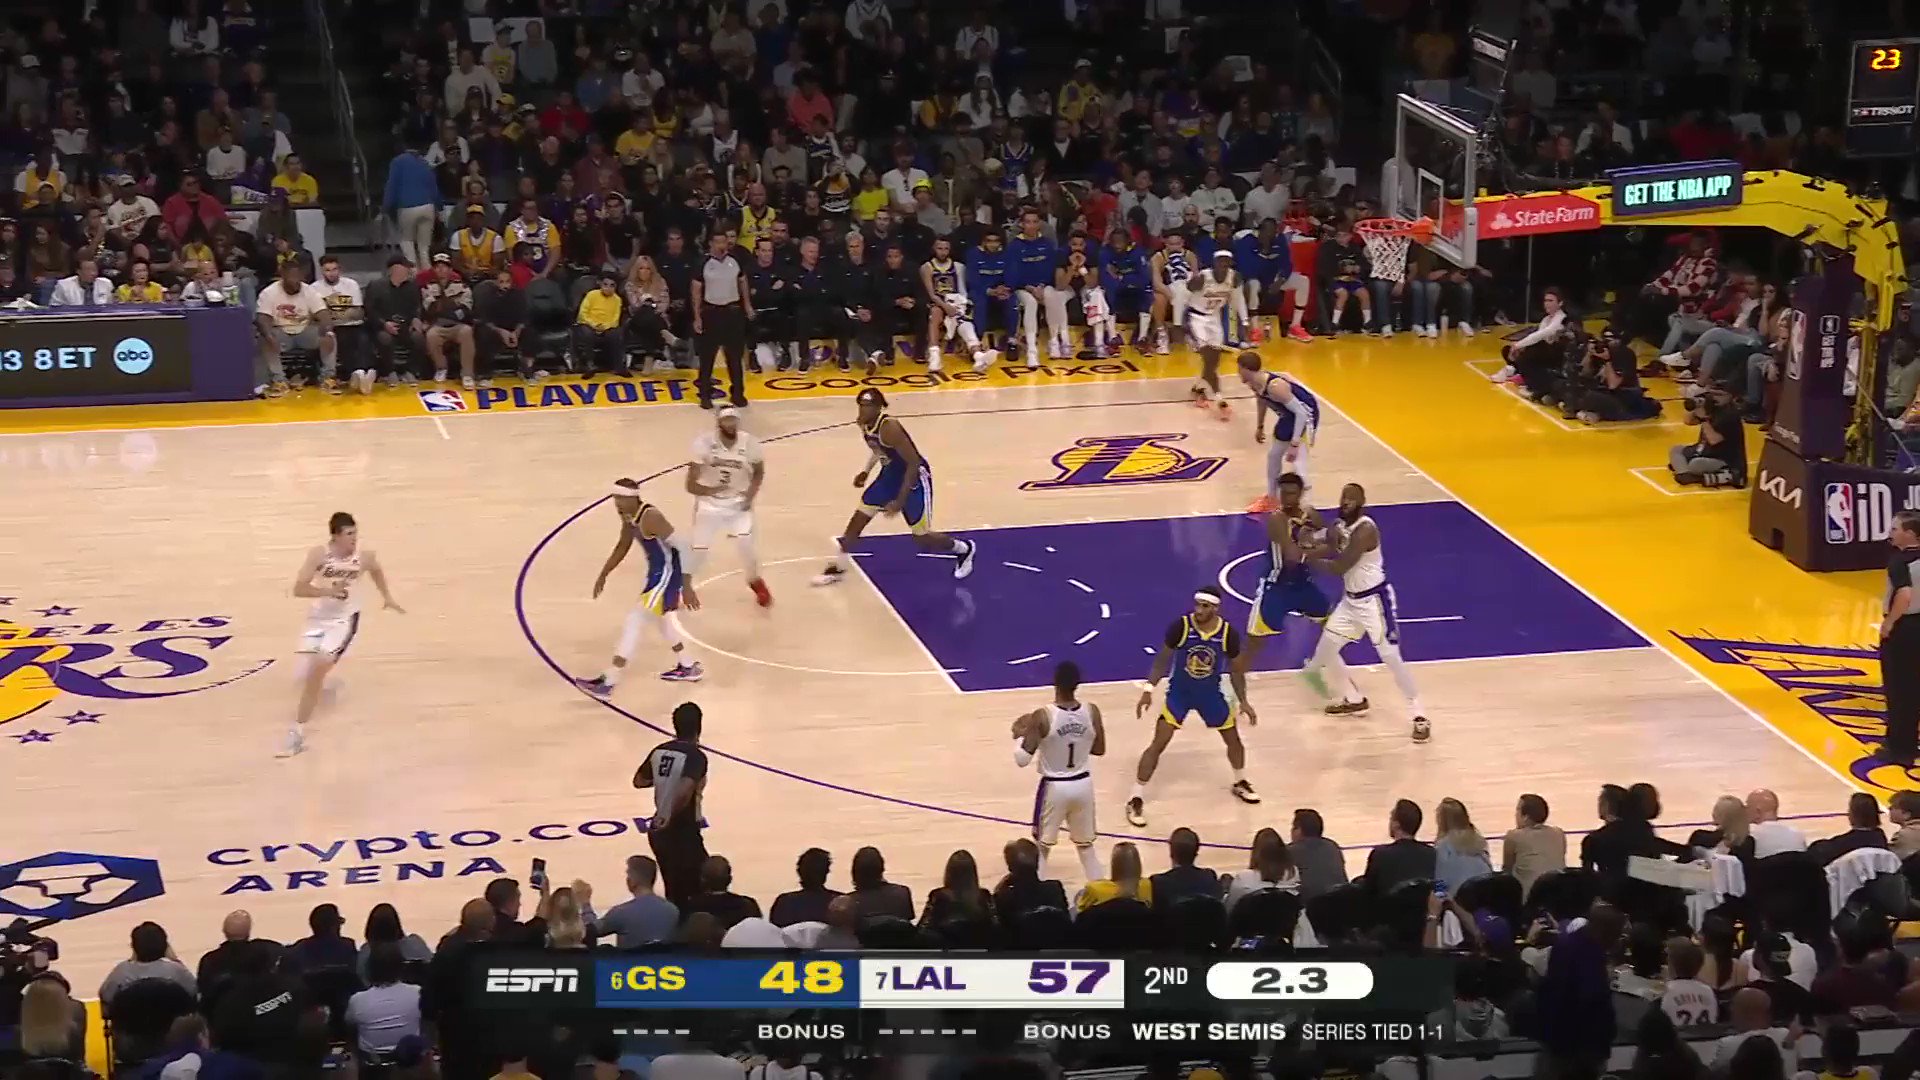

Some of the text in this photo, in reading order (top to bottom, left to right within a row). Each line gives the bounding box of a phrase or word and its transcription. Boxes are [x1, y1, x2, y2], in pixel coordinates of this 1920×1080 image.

[1871, 49, 1900, 70] 23
[1624, 175, 1732, 206] GET THE NBA APP
[117, 349, 150, 362] abc
[764, 370, 988, 391] Google
[1001, 360, 1140, 380] Pixel
[1066, 743, 1076, 768] 1
[220, 856, 509, 895] ARENA
